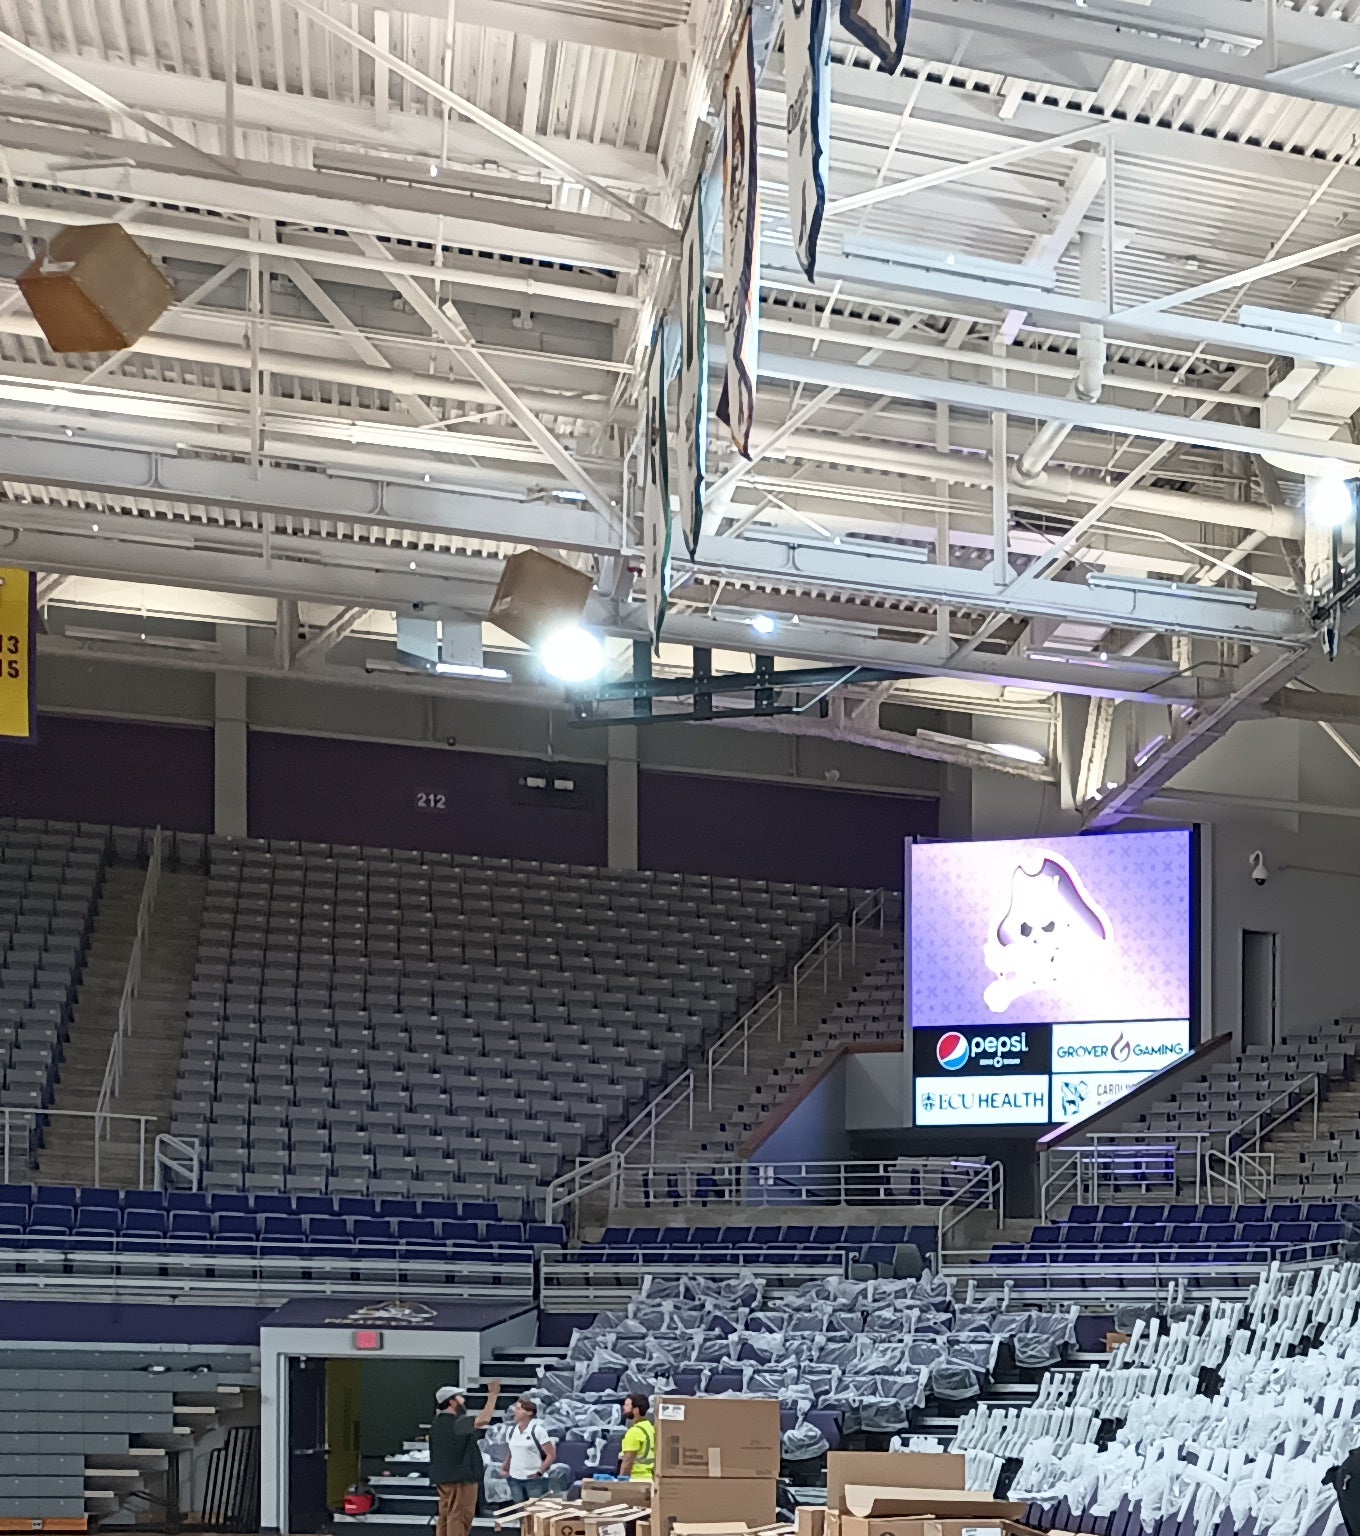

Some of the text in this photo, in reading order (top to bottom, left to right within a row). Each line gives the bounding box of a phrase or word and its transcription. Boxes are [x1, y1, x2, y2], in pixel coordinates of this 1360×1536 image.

[416, 792, 447, 809] 212
[971, 1032, 1029, 1058] pepsi
[1056, 1042, 1184, 1059] GROVER GAMING
[938, 1092, 1044, 1110] ECU HEALTH
